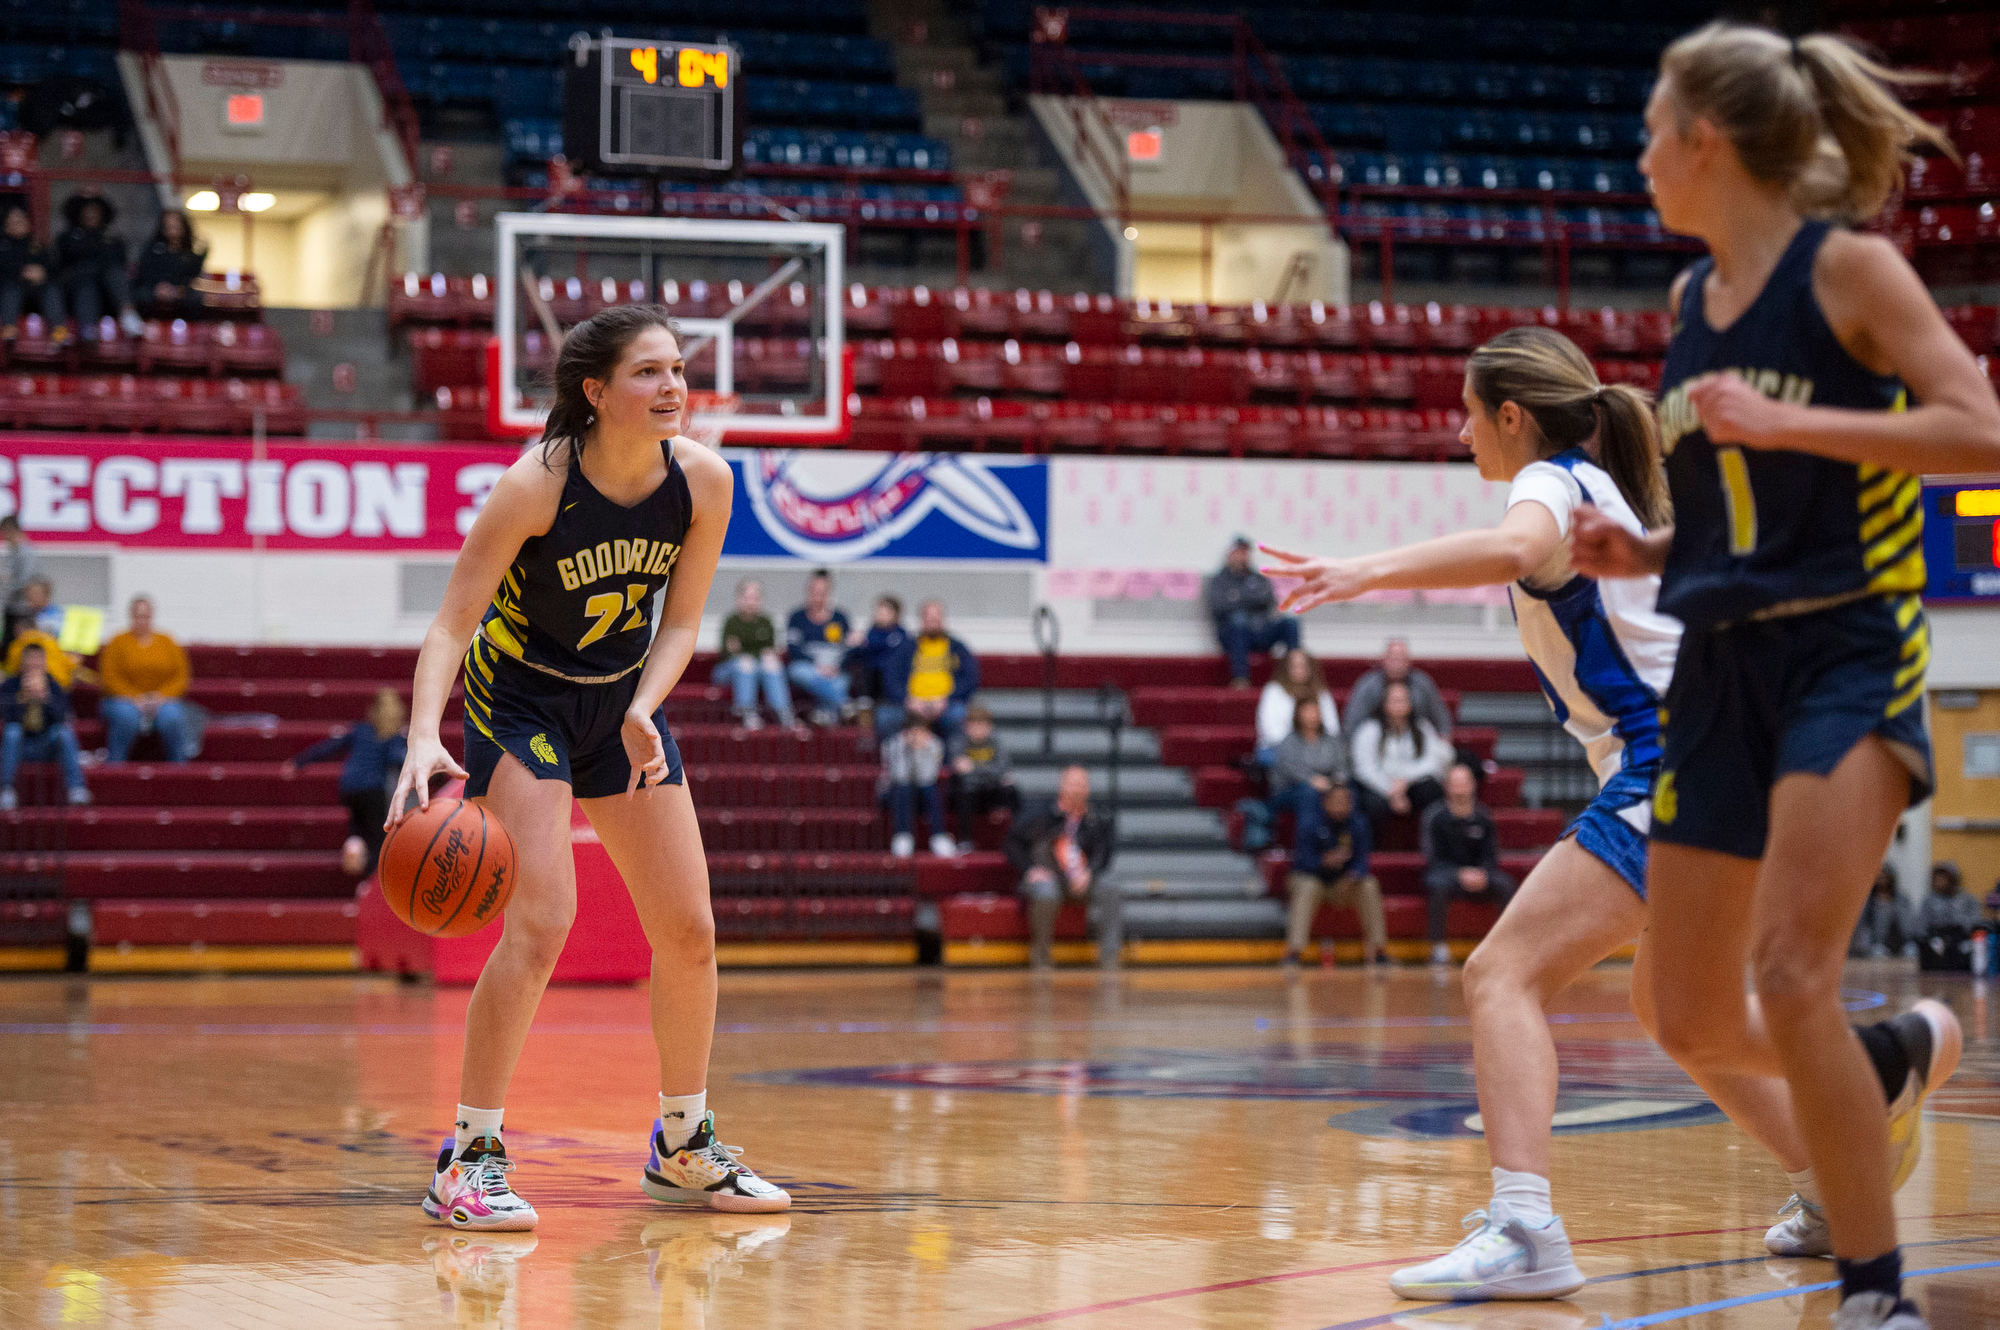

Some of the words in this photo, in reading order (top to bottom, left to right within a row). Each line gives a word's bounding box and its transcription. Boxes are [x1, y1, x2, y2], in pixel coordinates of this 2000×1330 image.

[0, 453, 428, 539] ECTION
[1716, 447, 1758, 557] 1
[421, 827, 470, 915] Rawlings
